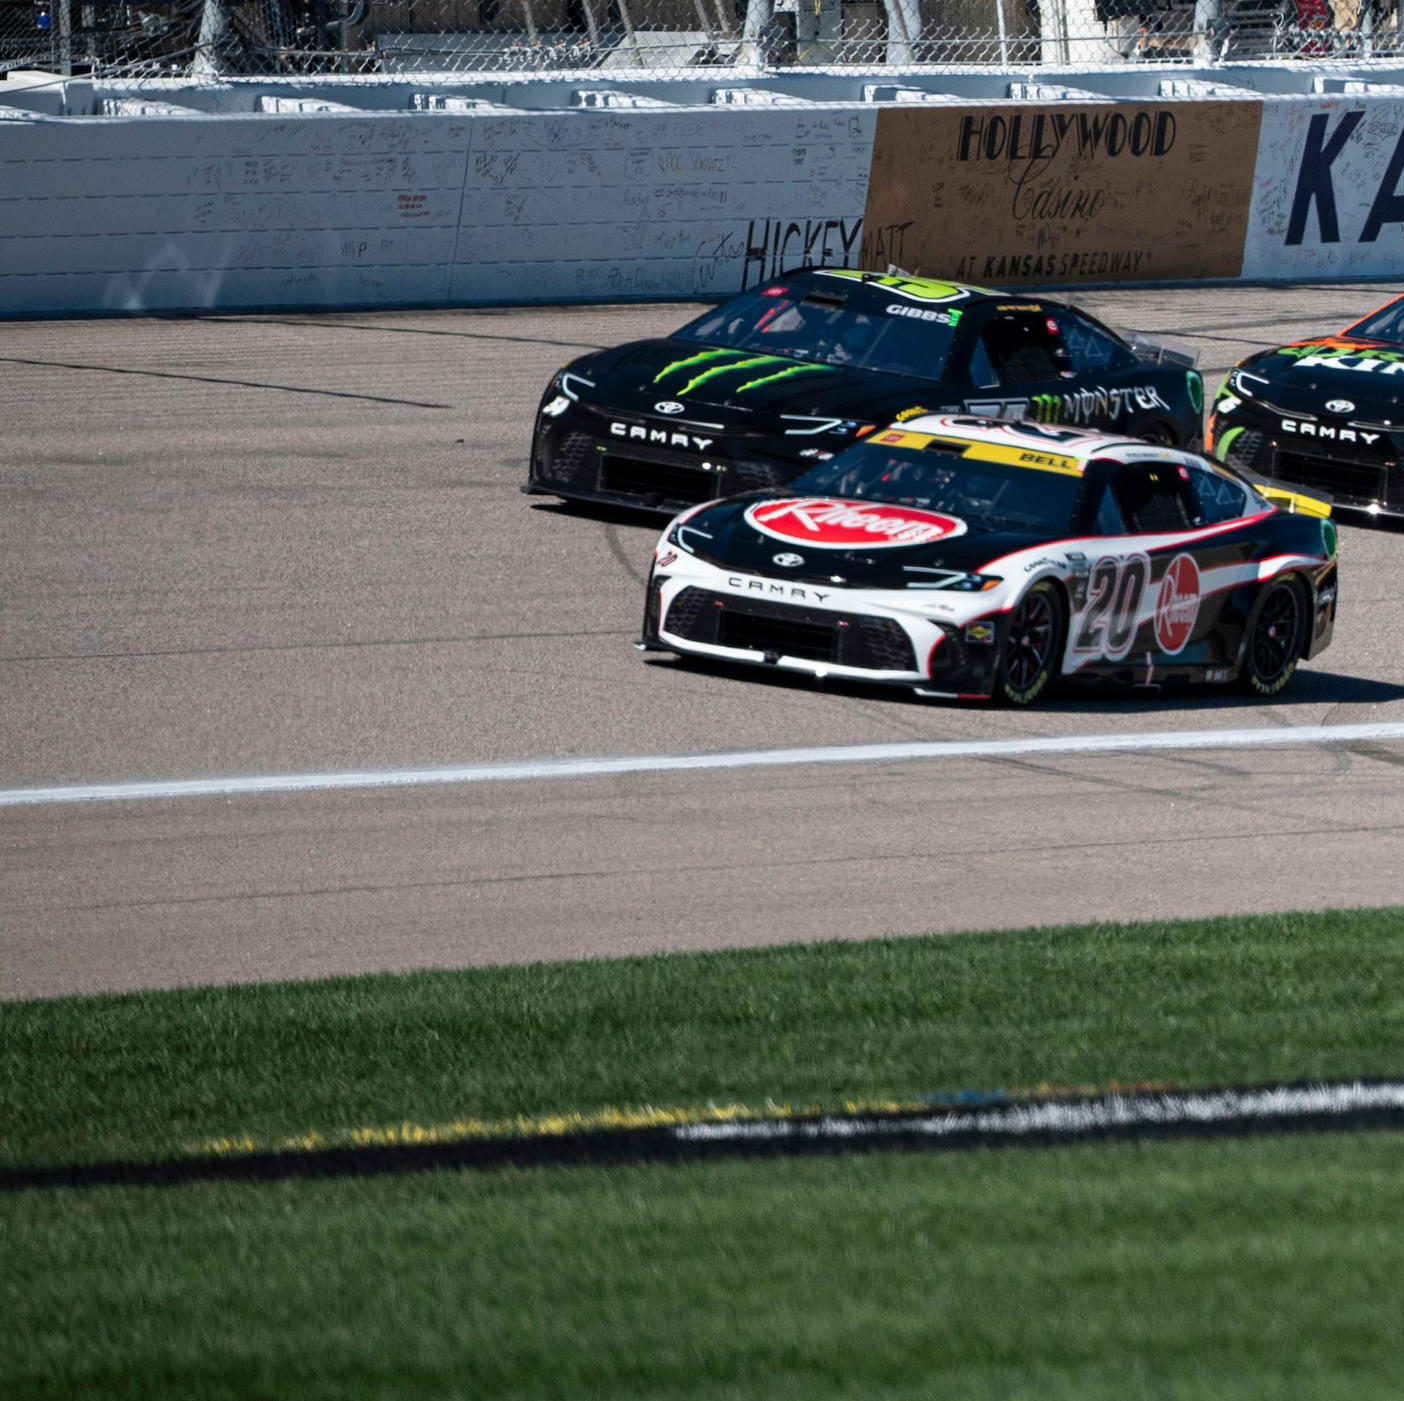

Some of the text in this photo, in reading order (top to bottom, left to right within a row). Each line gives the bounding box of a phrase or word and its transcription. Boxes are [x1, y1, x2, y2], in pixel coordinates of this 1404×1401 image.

[956, 111, 1177, 162] HOLLYWOOD
[1009, 144, 1106, 222] Casino
[740, 217, 866, 294] HICKEY
[956, 251, 1143, 280] AT KANSAS SPEEDWAY
[886, 304, 951, 324] GIBBS
[1064, 385, 1170, 424] MONSTER
[609, 422, 714, 450] CAMRY
[1281, 419, 1380, 445] CAMRY
[1019, 452, 1073, 471] BELL
[757, 497, 944, 543] Rheem
[728, 576, 830, 603] CAMRY
[1073, 551, 1151, 661] 20
